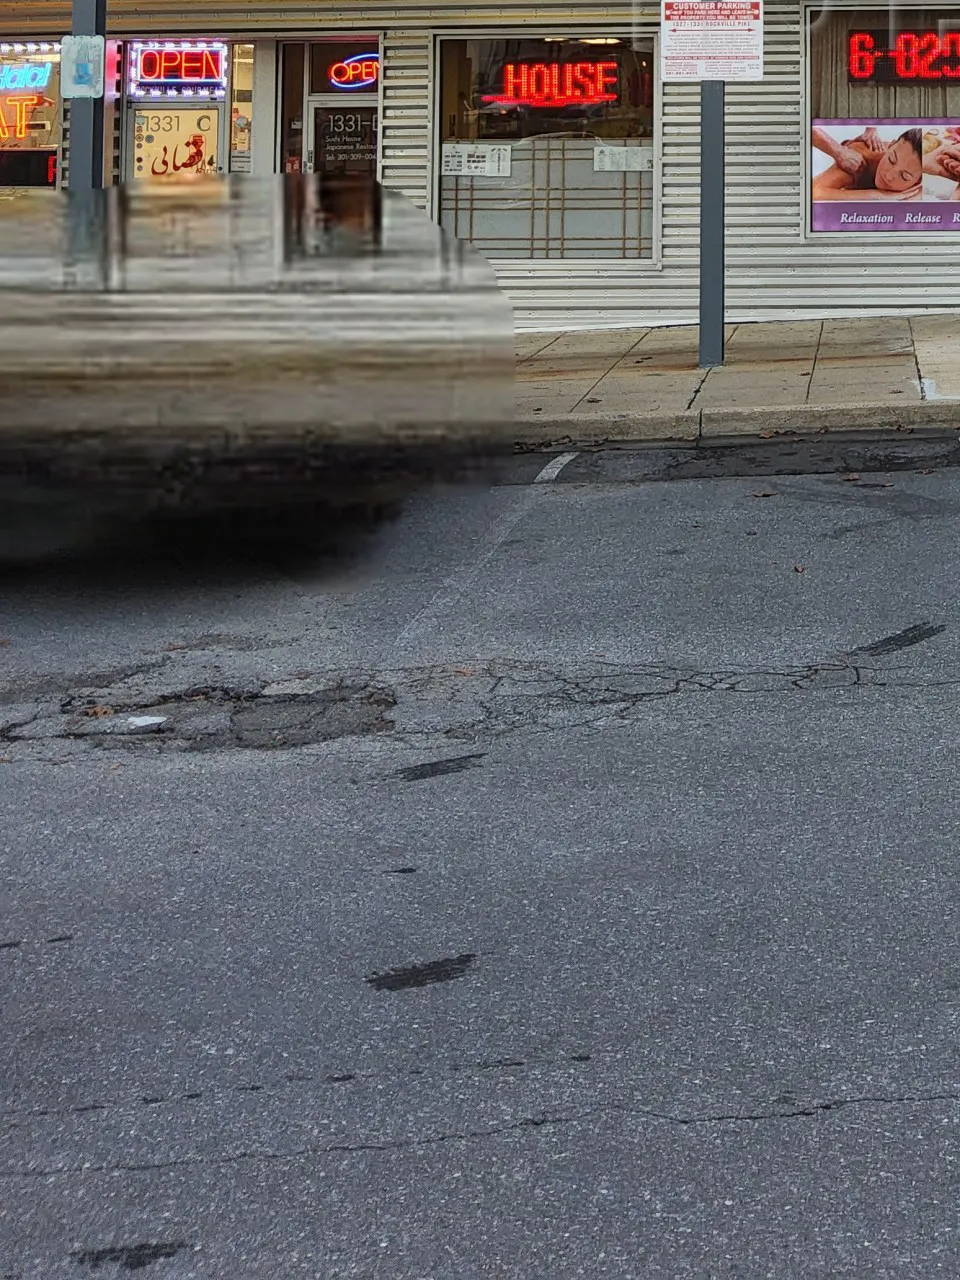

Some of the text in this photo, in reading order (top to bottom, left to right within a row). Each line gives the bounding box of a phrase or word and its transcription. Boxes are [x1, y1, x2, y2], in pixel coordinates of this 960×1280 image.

[673, 2, 751, 10] CUSTOMER PARKING
[140, 50, 222, 79] OPEN
[505, 62, 617, 100] HOUSE
[144, 115, 211, 132] 1331 C
[326, 143, 354, 151] Japanese
[840, 213, 894, 224] Relaxation
[905, 213, 942, 224] Release
